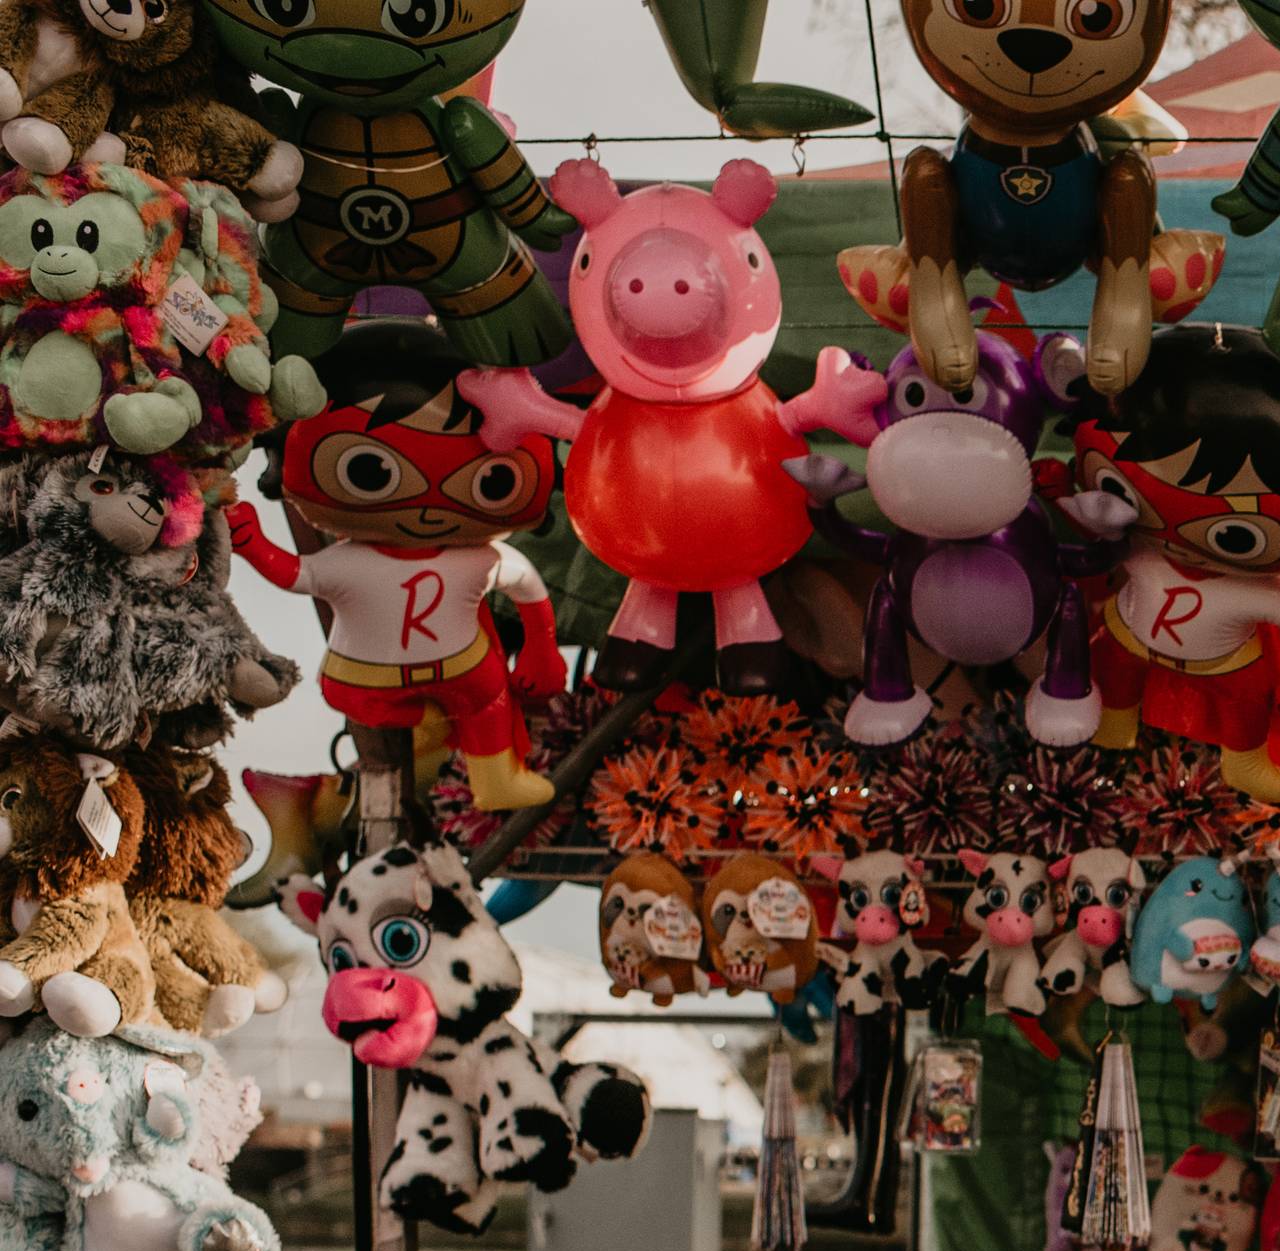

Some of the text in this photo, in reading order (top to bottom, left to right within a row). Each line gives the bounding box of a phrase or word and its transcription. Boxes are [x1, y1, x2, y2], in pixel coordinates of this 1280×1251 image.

[360, 205, 392, 229] M
[401, 570, 444, 649] R
[1151, 587, 1202, 645] R
